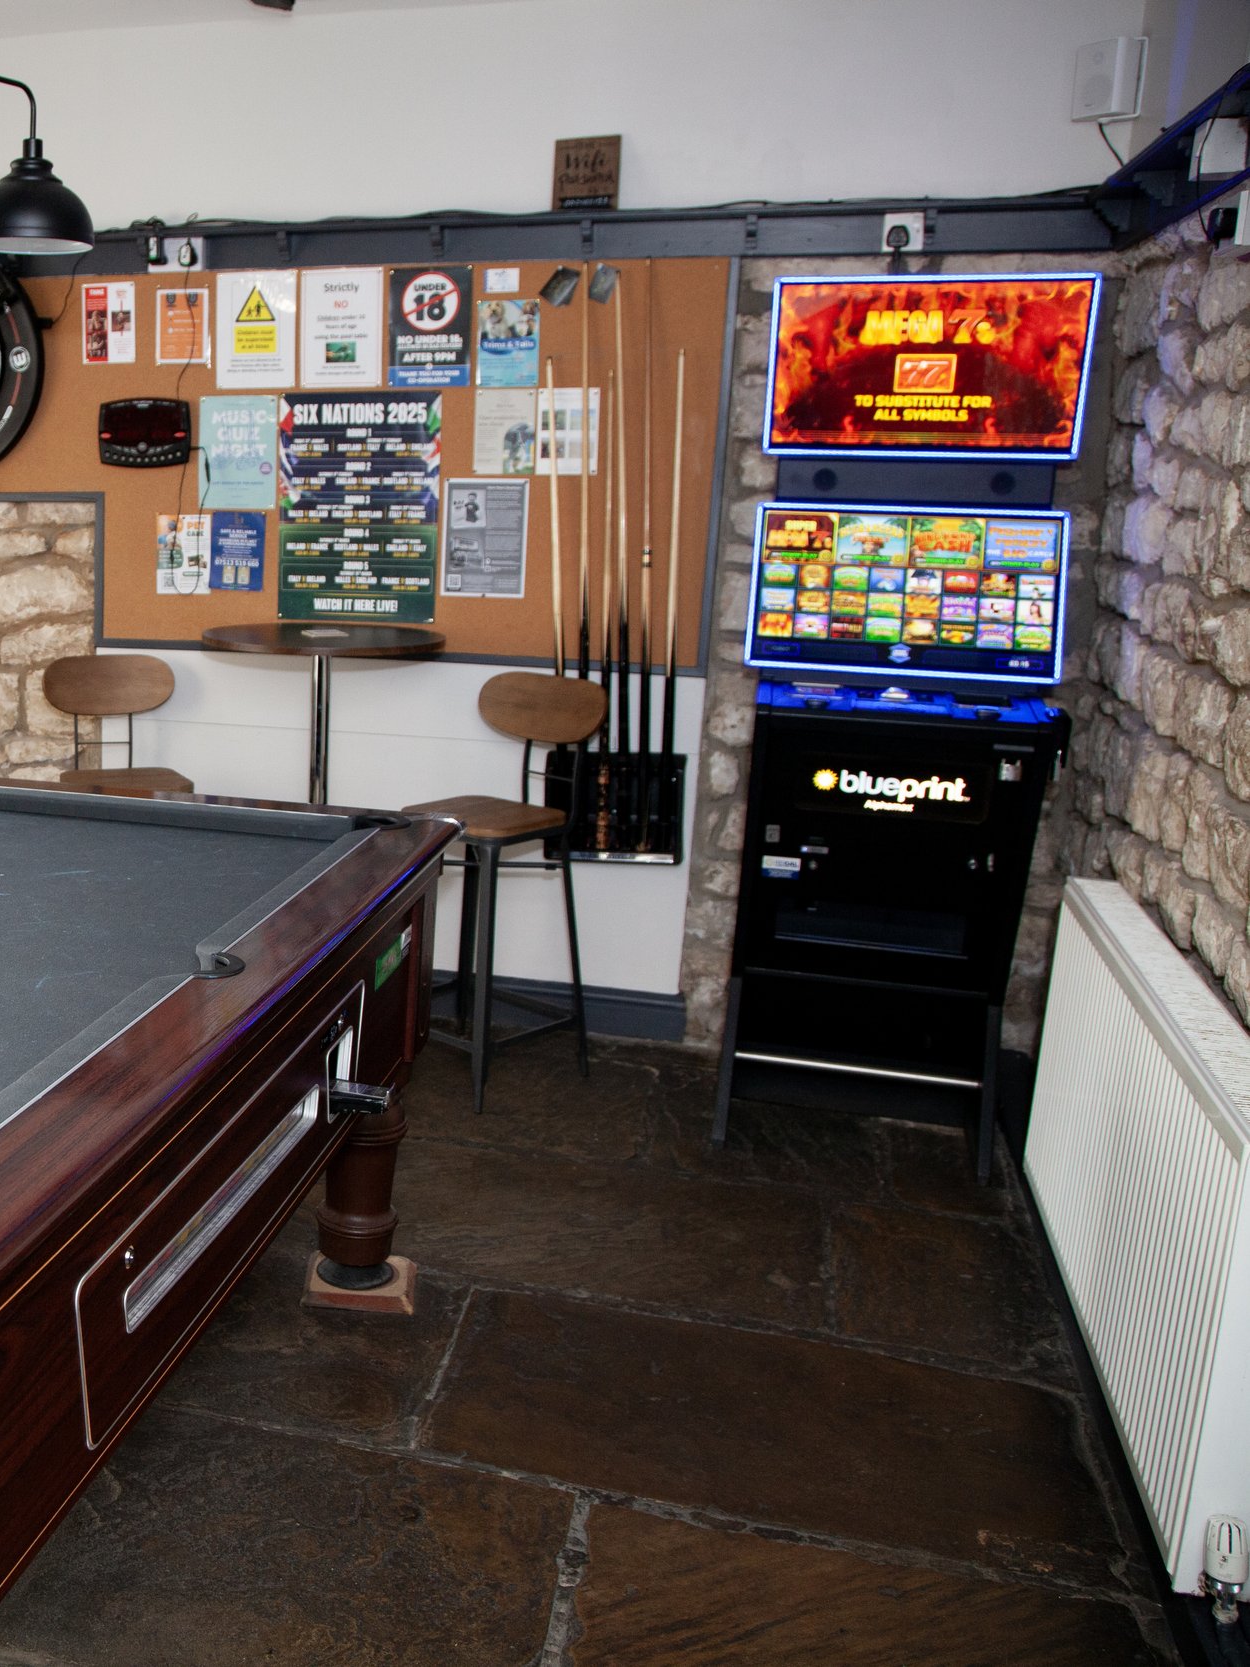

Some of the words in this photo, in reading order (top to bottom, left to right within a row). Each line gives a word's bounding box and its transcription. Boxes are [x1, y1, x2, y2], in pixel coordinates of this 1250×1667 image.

[324, 282, 359, 293] Strictly
[414, 283, 447, 292] UNDER
[334, 300, 349, 309] NO
[413, 292, 446, 321] 18
[859, 309, 943, 345] MEGA
[397, 335, 414, 344] NO
[414, 334, 448, 344] UNDER
[403, 352, 433, 362] AFTER
[434, 352, 456, 362] 9PM
[854, 394, 873, 407] TO
[875, 396, 960, 408] SUBSTITUTE
[963, 396, 992, 408] FOR
[212, 410, 267, 424] MUSIC
[293, 402, 318, 424] SIX
[322, 402, 384, 424] NATIONS
[387, 402, 428, 424] 2025
[873, 410, 900, 421] ALL
[902, 410, 968, 422] SYMBOLS
[346, 428, 367, 438] ROUND
[212, 444, 268, 457] NIGHT
[346, 462, 366, 471] ROUND
[366, 462, 372, 470] 2
[344, 495, 365, 504] ROUND
[366, 496, 370, 504] 3
[344, 528, 364, 538] ROUND
[364, 528, 370, 538] 4
[343, 561, 363, 570] ROUND
[364, 561, 369, 570] 5
[314, 598, 342, 610] WATCH
[344, 598, 353, 610] IT
[354, 598, 375, 612] HERE
[376, 599, 398, 612] LIVE!
[839, 769, 967, 802] blueprint
